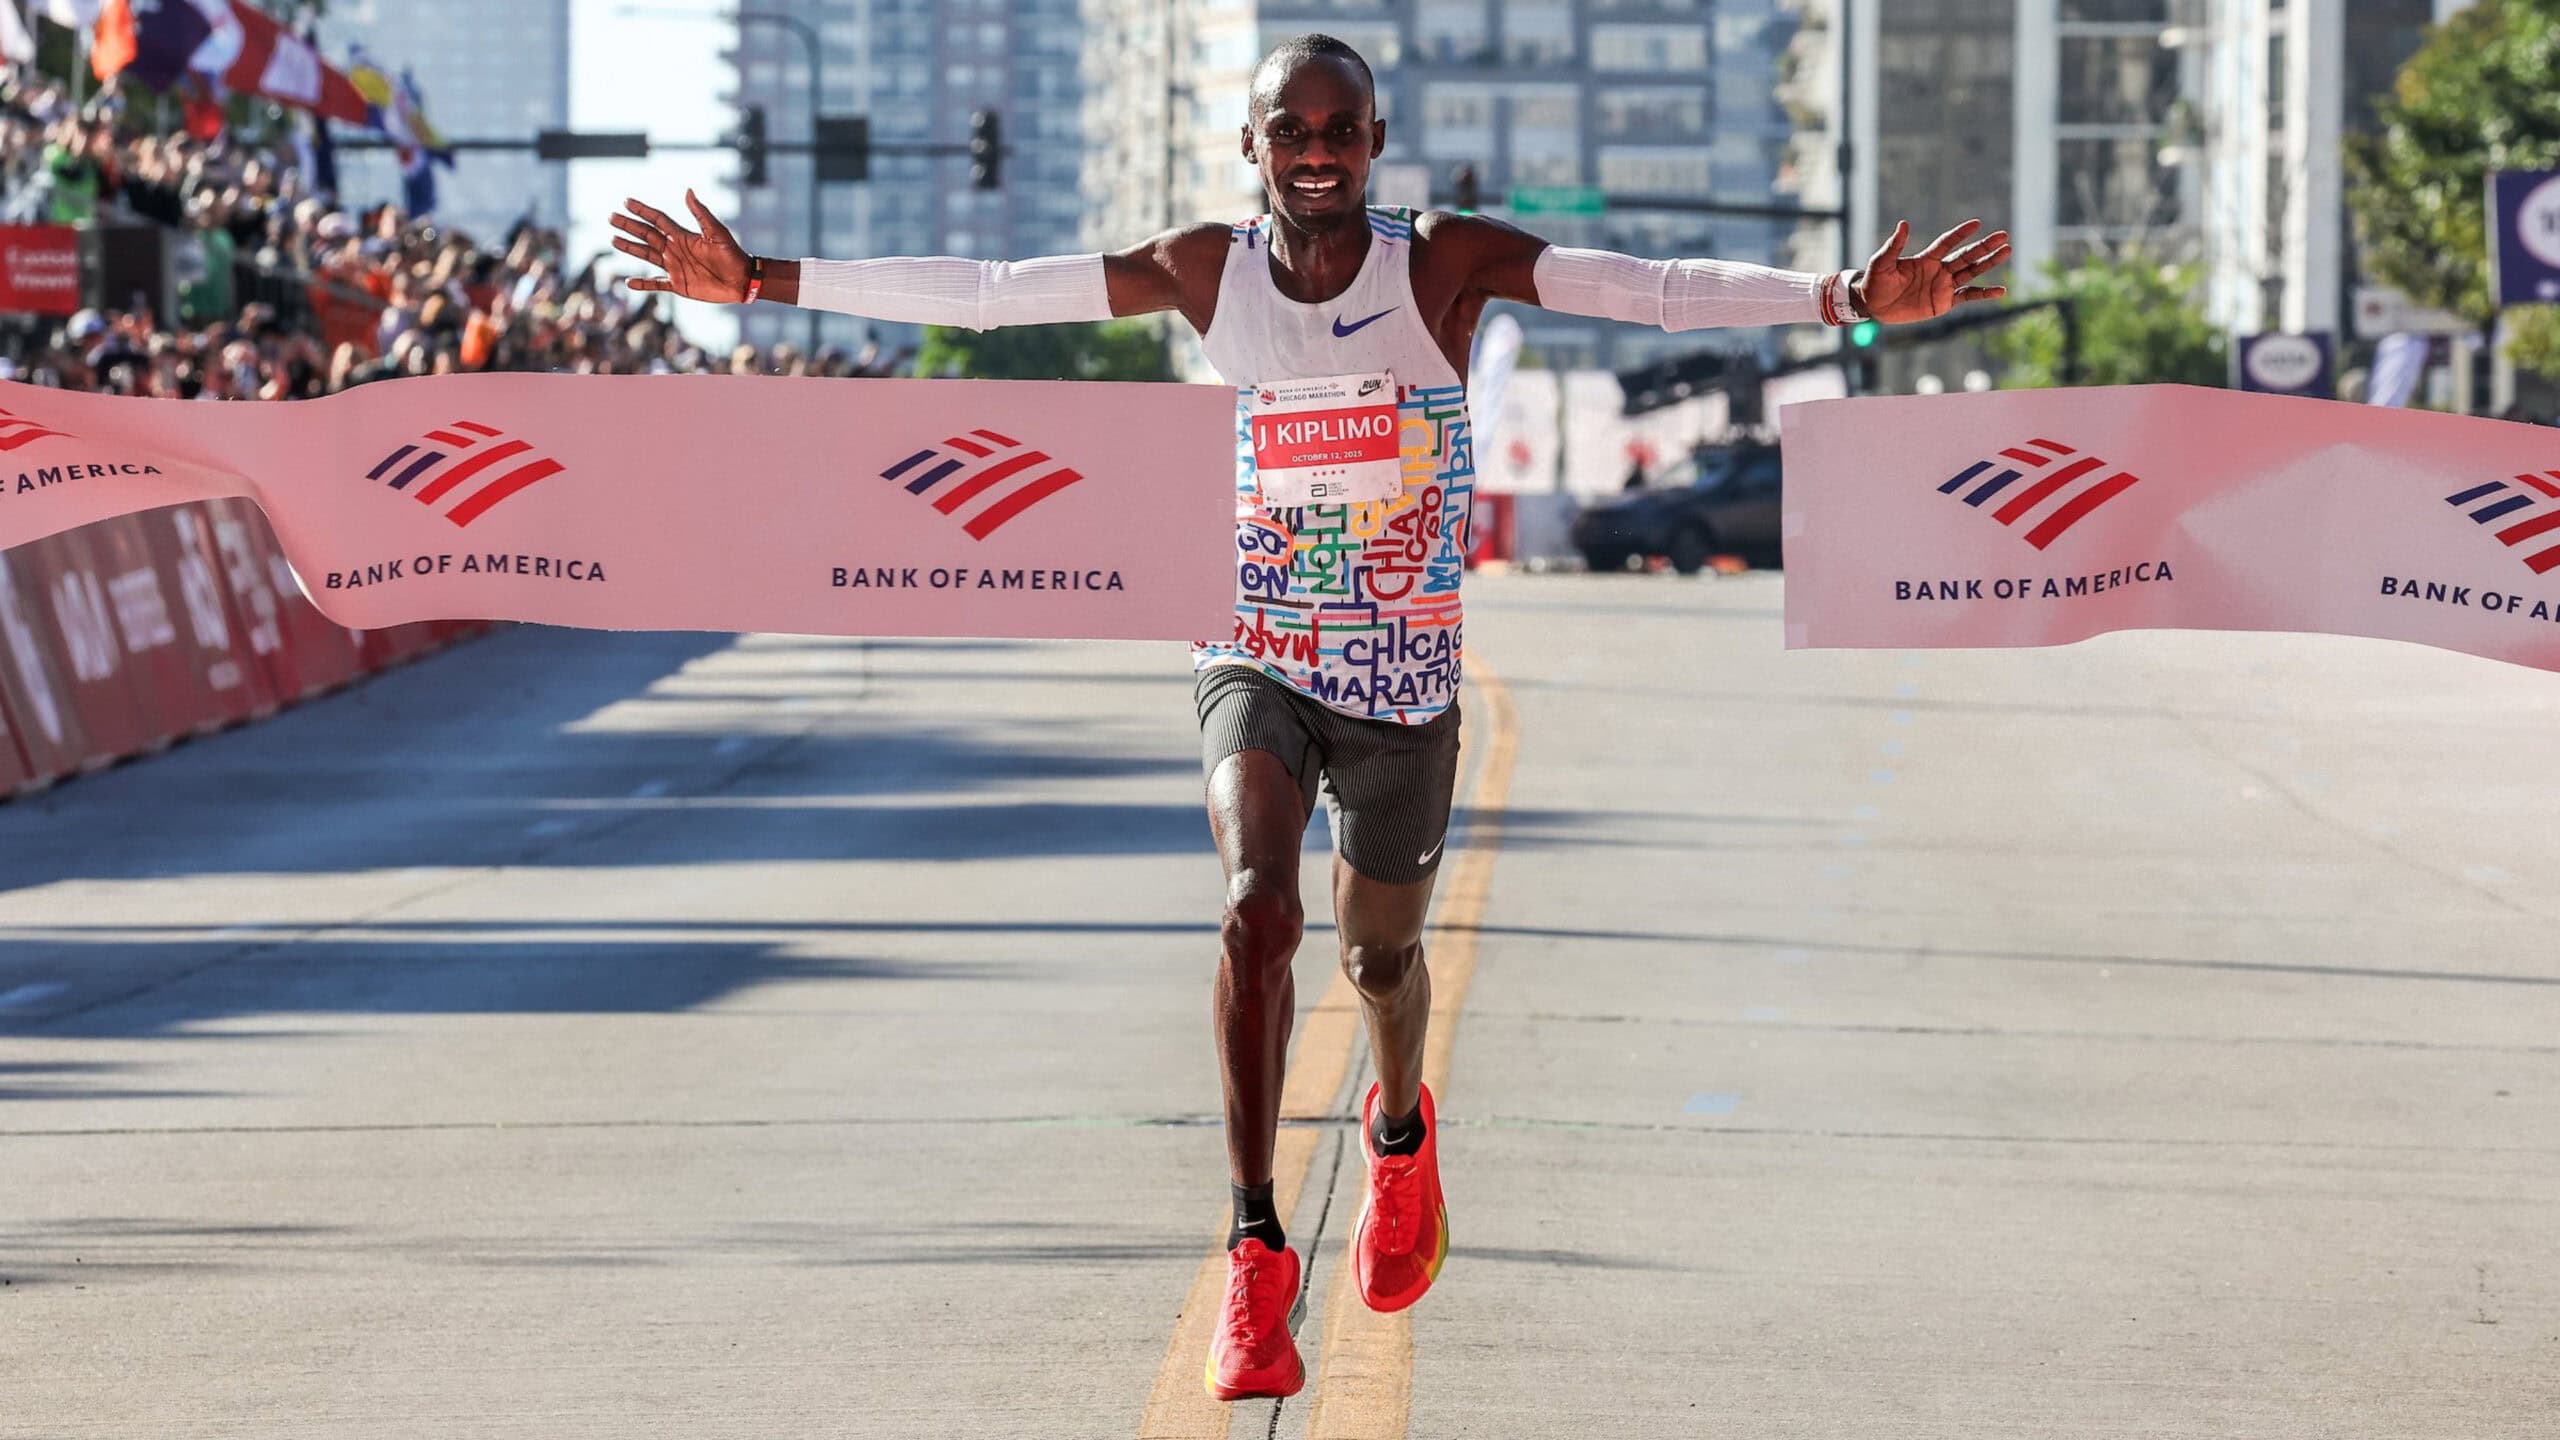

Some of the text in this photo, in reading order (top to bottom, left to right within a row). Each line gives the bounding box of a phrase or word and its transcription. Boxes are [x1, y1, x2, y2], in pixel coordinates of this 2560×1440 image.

[1279, 391, 1346, 401] CHICAGO MARATHON
[1362, 379, 1382, 389] RUN
[1257, 414, 1393, 451] J KIPLIMO
[1291, 452, 1328, 463] OCTOBER
[17, 464, 162, 494] AMERICA
[326, 555, 403, 589] BANK
[413, 554, 452, 575] OF
[462, 554, 605, 583] AMERICA
[832, 567, 1124, 591] BANK OF AMERICA
[1895, 561, 2173, 601] BANK OF AMERICA
[2380, 576, 2471, 606] BANK
[2481, 591, 2523, 614] OF
